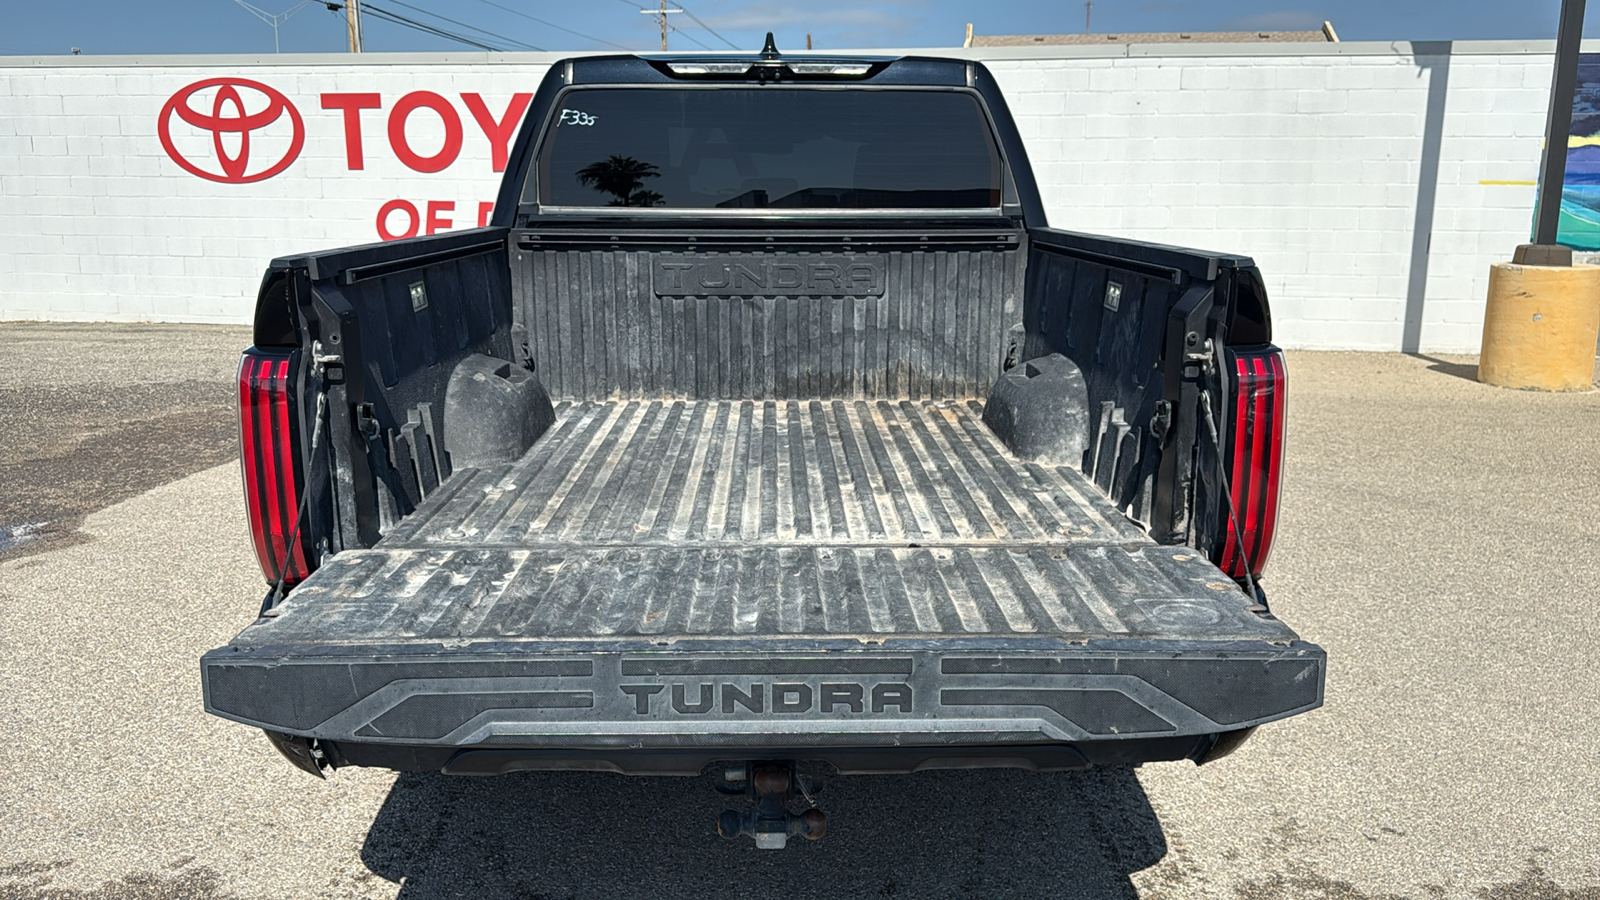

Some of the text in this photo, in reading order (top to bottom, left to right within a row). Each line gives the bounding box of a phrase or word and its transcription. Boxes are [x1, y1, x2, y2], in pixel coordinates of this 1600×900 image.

[320, 90, 534, 173] TOY
[376, 199, 455, 241] OF
[661, 263, 878, 289] TUNDRA
[620, 682, 913, 714] TUNDRA
